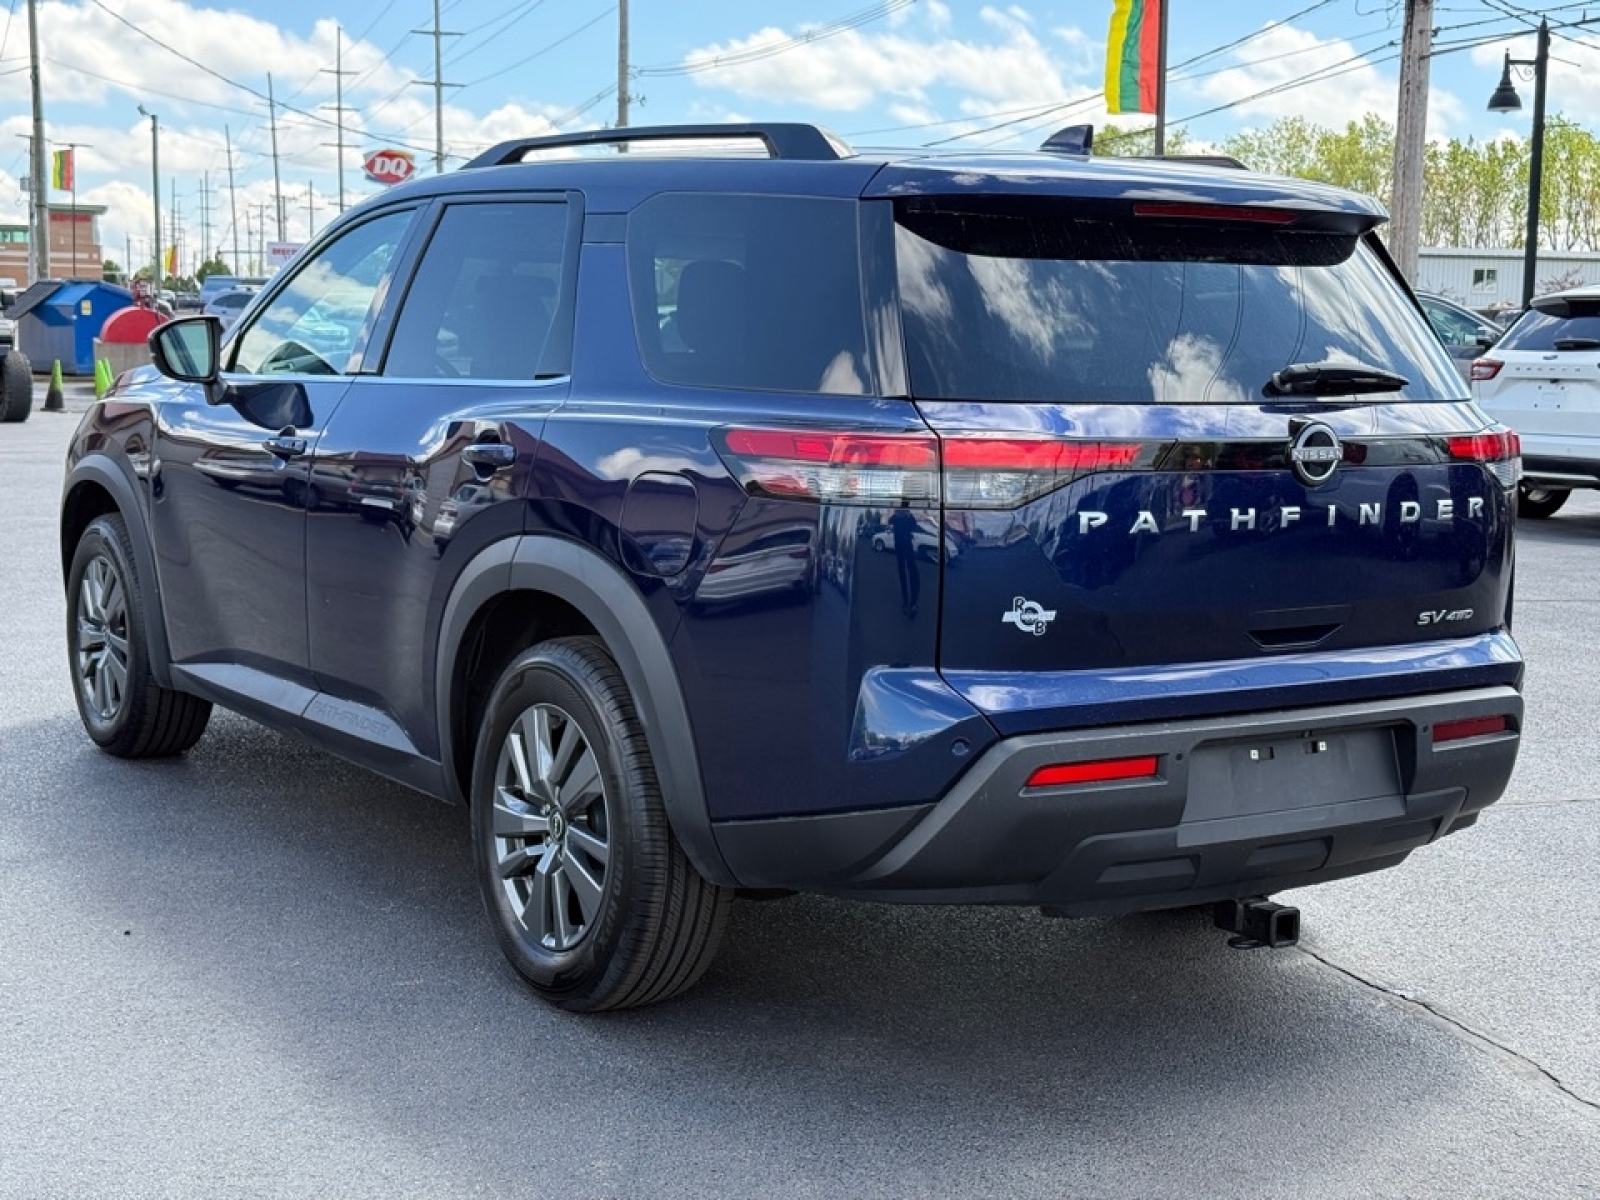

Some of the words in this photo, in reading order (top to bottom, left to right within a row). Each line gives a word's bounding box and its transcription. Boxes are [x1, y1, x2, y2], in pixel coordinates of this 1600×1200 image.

[373, 156, 407, 177] DQ
[1292, 447, 1343, 461] NISSAN
[1078, 496, 1485, 535] PATHFINDER
[1417, 609, 1447, 626] SV
